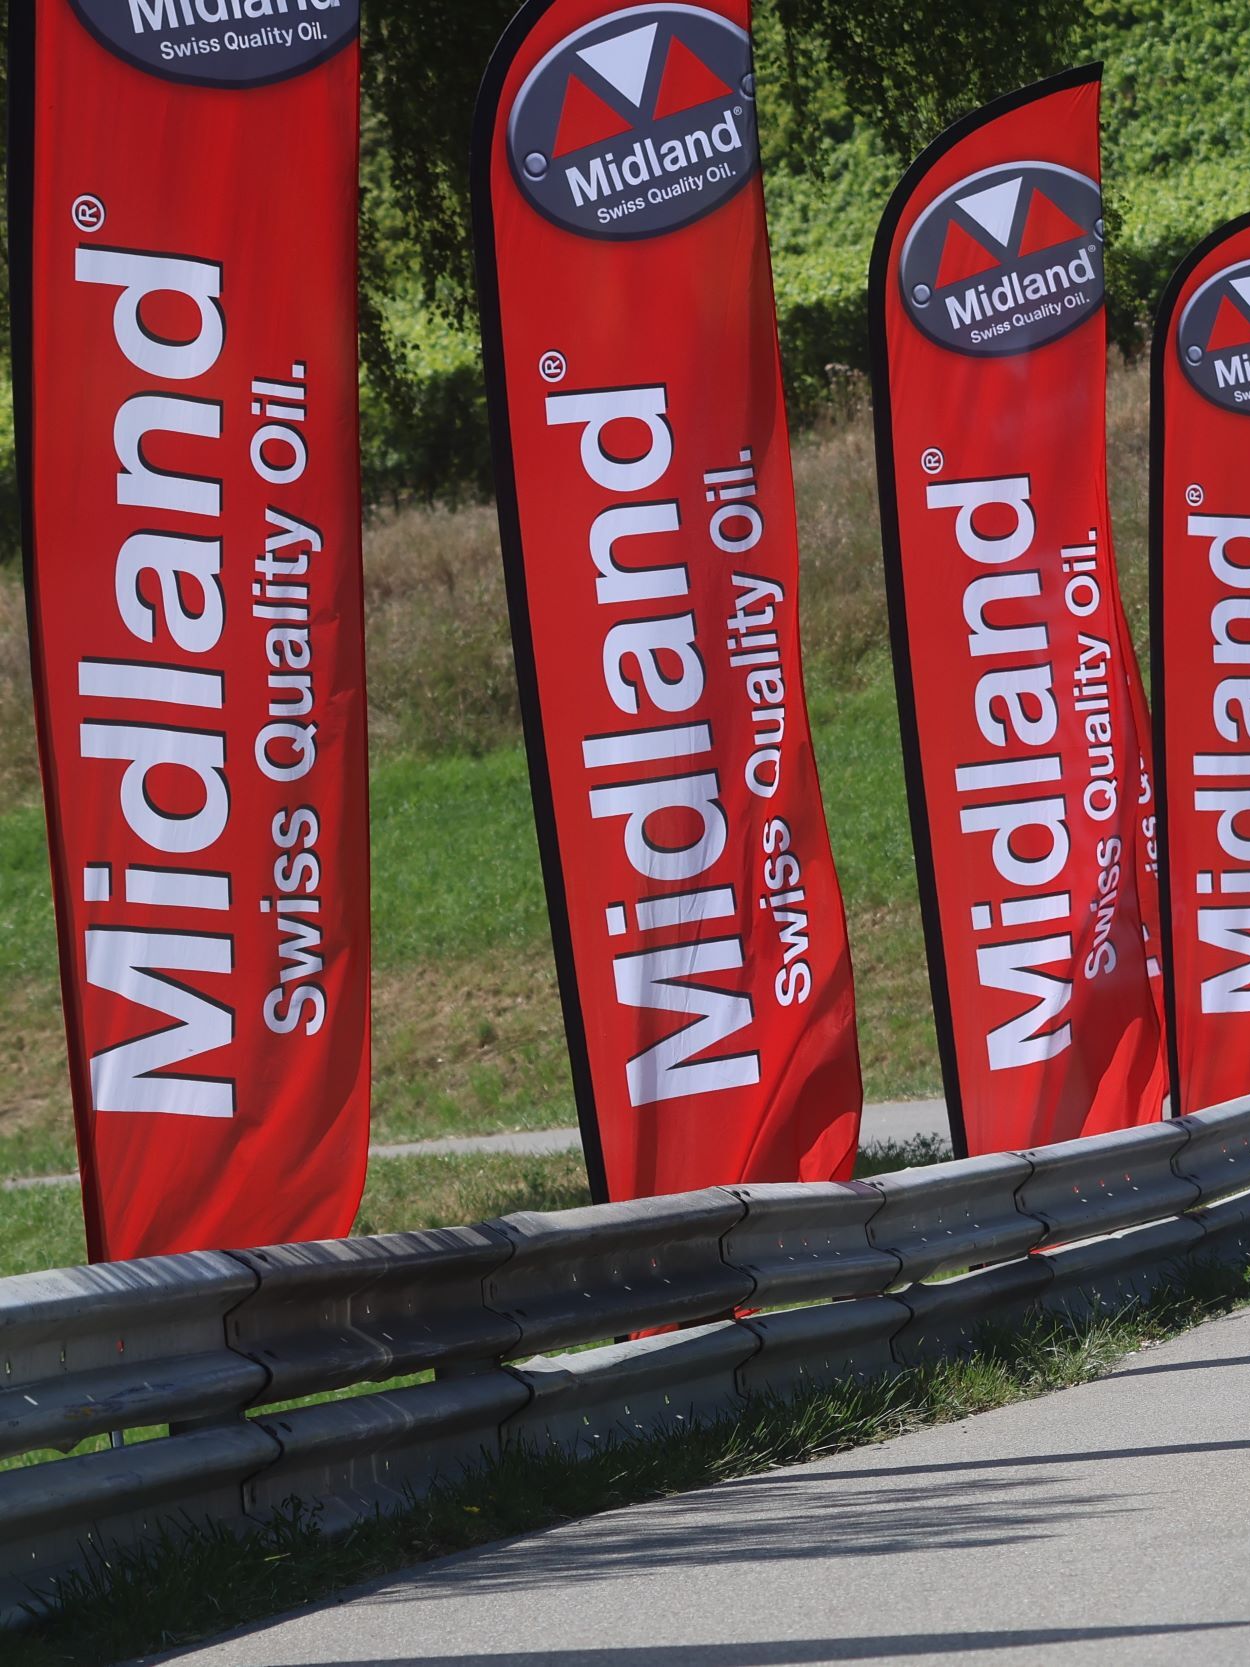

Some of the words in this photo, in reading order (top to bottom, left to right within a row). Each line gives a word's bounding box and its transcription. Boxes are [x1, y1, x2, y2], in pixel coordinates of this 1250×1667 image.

[159, 37, 221, 60] Swiss
[223, 27, 294, 51] Quality
[297, 22, 328, 41] Oil.
[597, 197, 645, 224] Swiss
[647, 175, 703, 204] Quality
[706, 162, 736, 183] Oil.
[970, 321, 1011, 343] Swiss
[1012, 302, 1062, 327] Quality
[1064, 291, 1090, 309] Oil.
[249, 360, 309, 485] Oil.
[703, 446, 766, 555] Oil.
[1060, 527, 1101, 618] Oil.
[251, 507, 324, 784] Quality
[725, 570, 785, 799] Quality
[1073, 631, 1117, 823] Quality
[260, 804, 326, 1038] Swiss
[755, 814, 812, 1007] Swiss
[1085, 834, 1123, 981] Swiss
